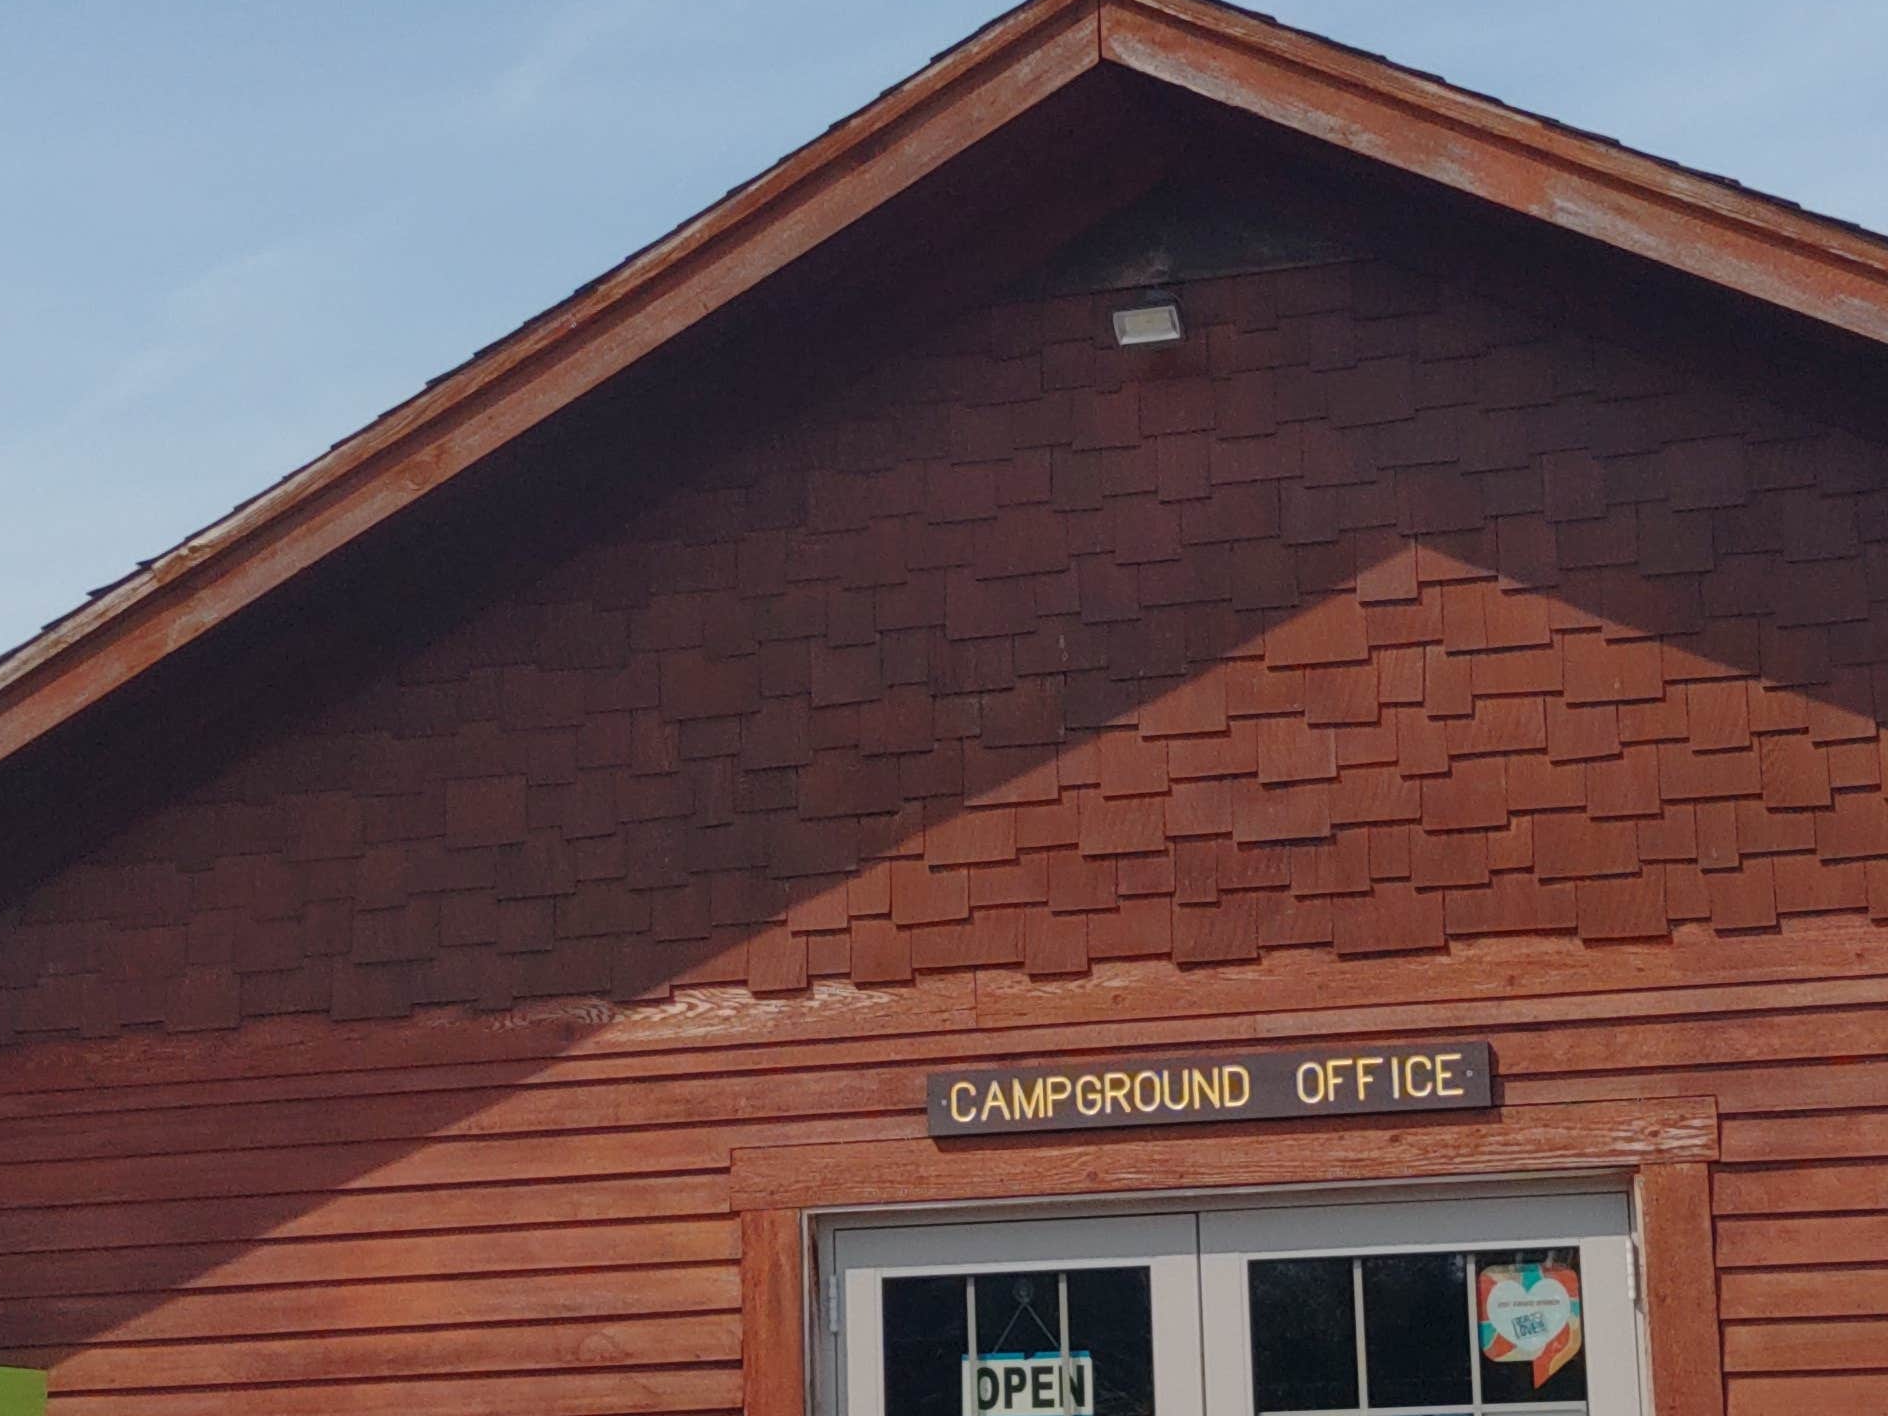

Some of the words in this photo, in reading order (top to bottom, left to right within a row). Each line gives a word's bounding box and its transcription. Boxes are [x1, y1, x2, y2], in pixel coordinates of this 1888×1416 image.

[949, 1063, 1250, 1123] CAMPGROUND
[1296, 1052, 1464, 1105] OFFICE
[976, 1364, 1086, 1411] OPEN
